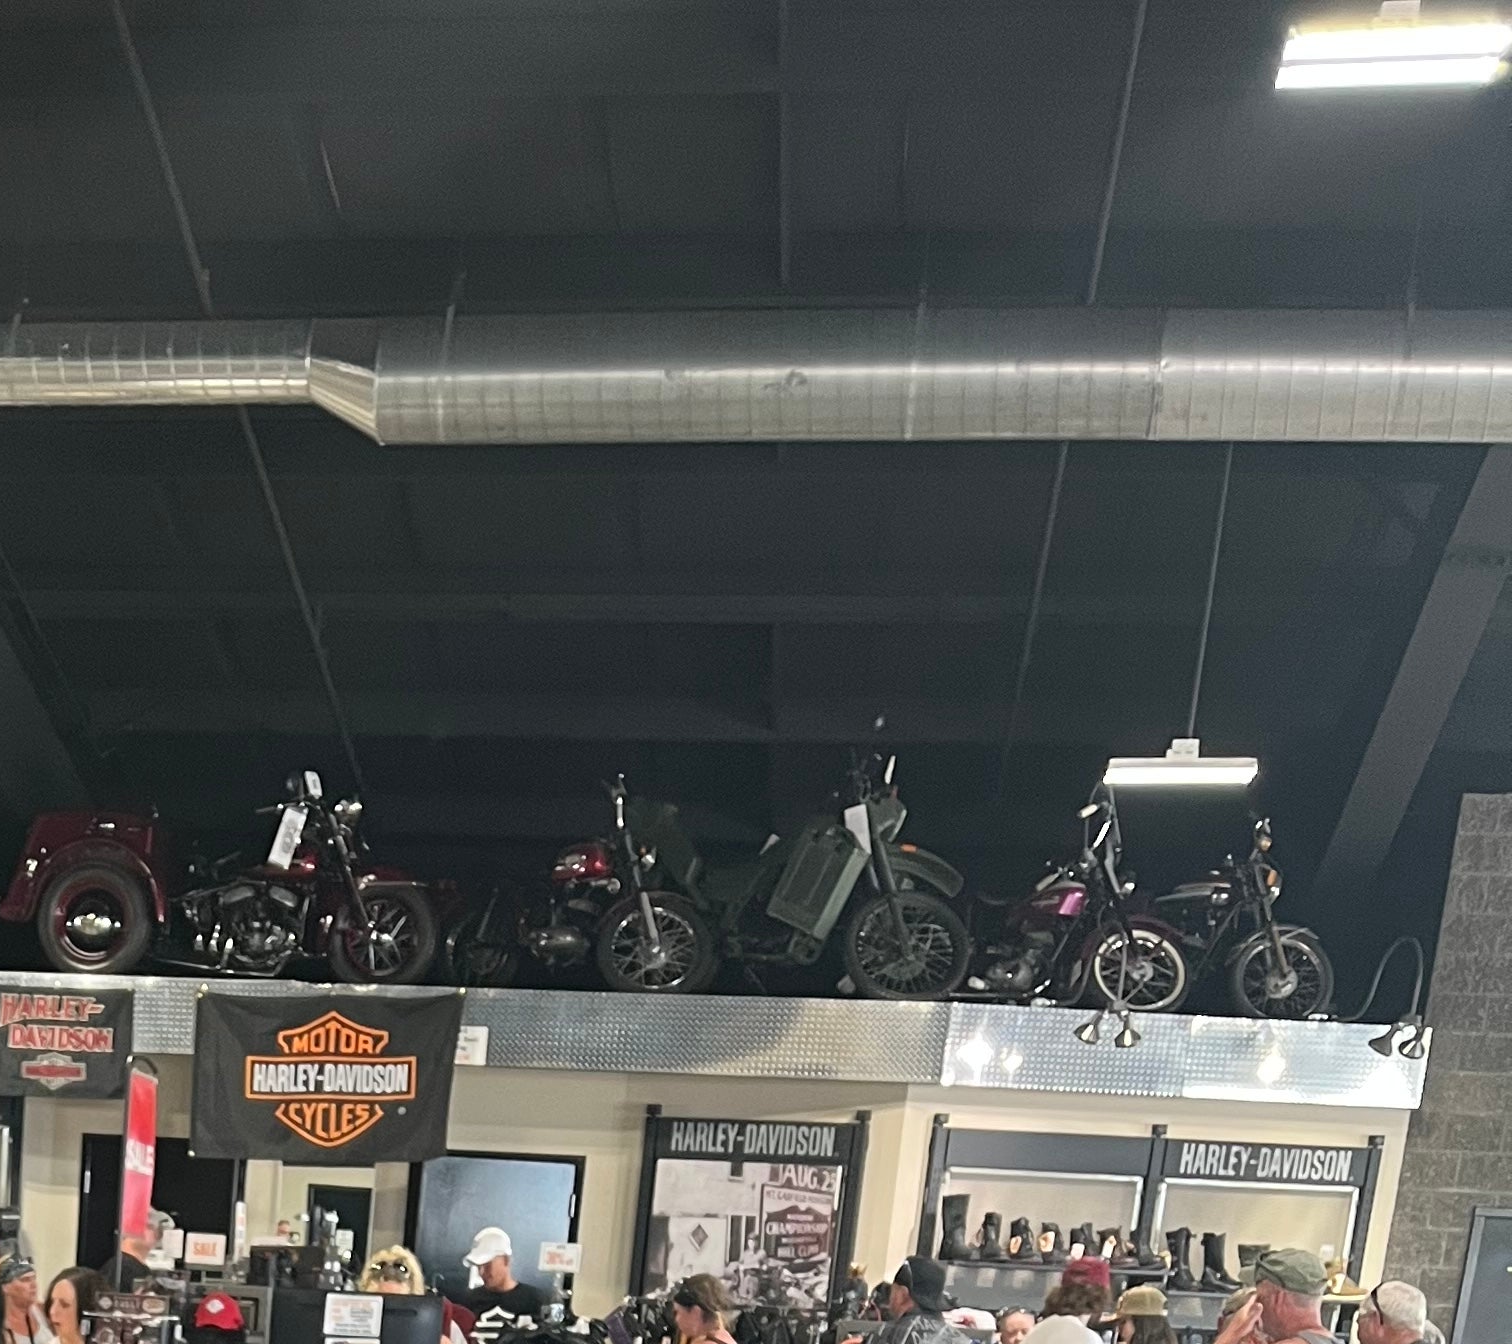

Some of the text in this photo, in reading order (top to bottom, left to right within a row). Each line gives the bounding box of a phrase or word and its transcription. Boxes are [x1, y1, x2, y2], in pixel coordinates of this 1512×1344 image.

[8, 1024, 114, 1053] DAVIDSON
[292, 1021, 374, 1054] MOTOR
[253, 1063, 409, 1094] HARLEY-DAVIDSON
[289, 1103, 370, 1139] CYCLES
[671, 1121, 836, 1157] HARLEY-DAVIDSON
[1179, 1143, 1353, 1182] HARLEY-DAVIDSON
